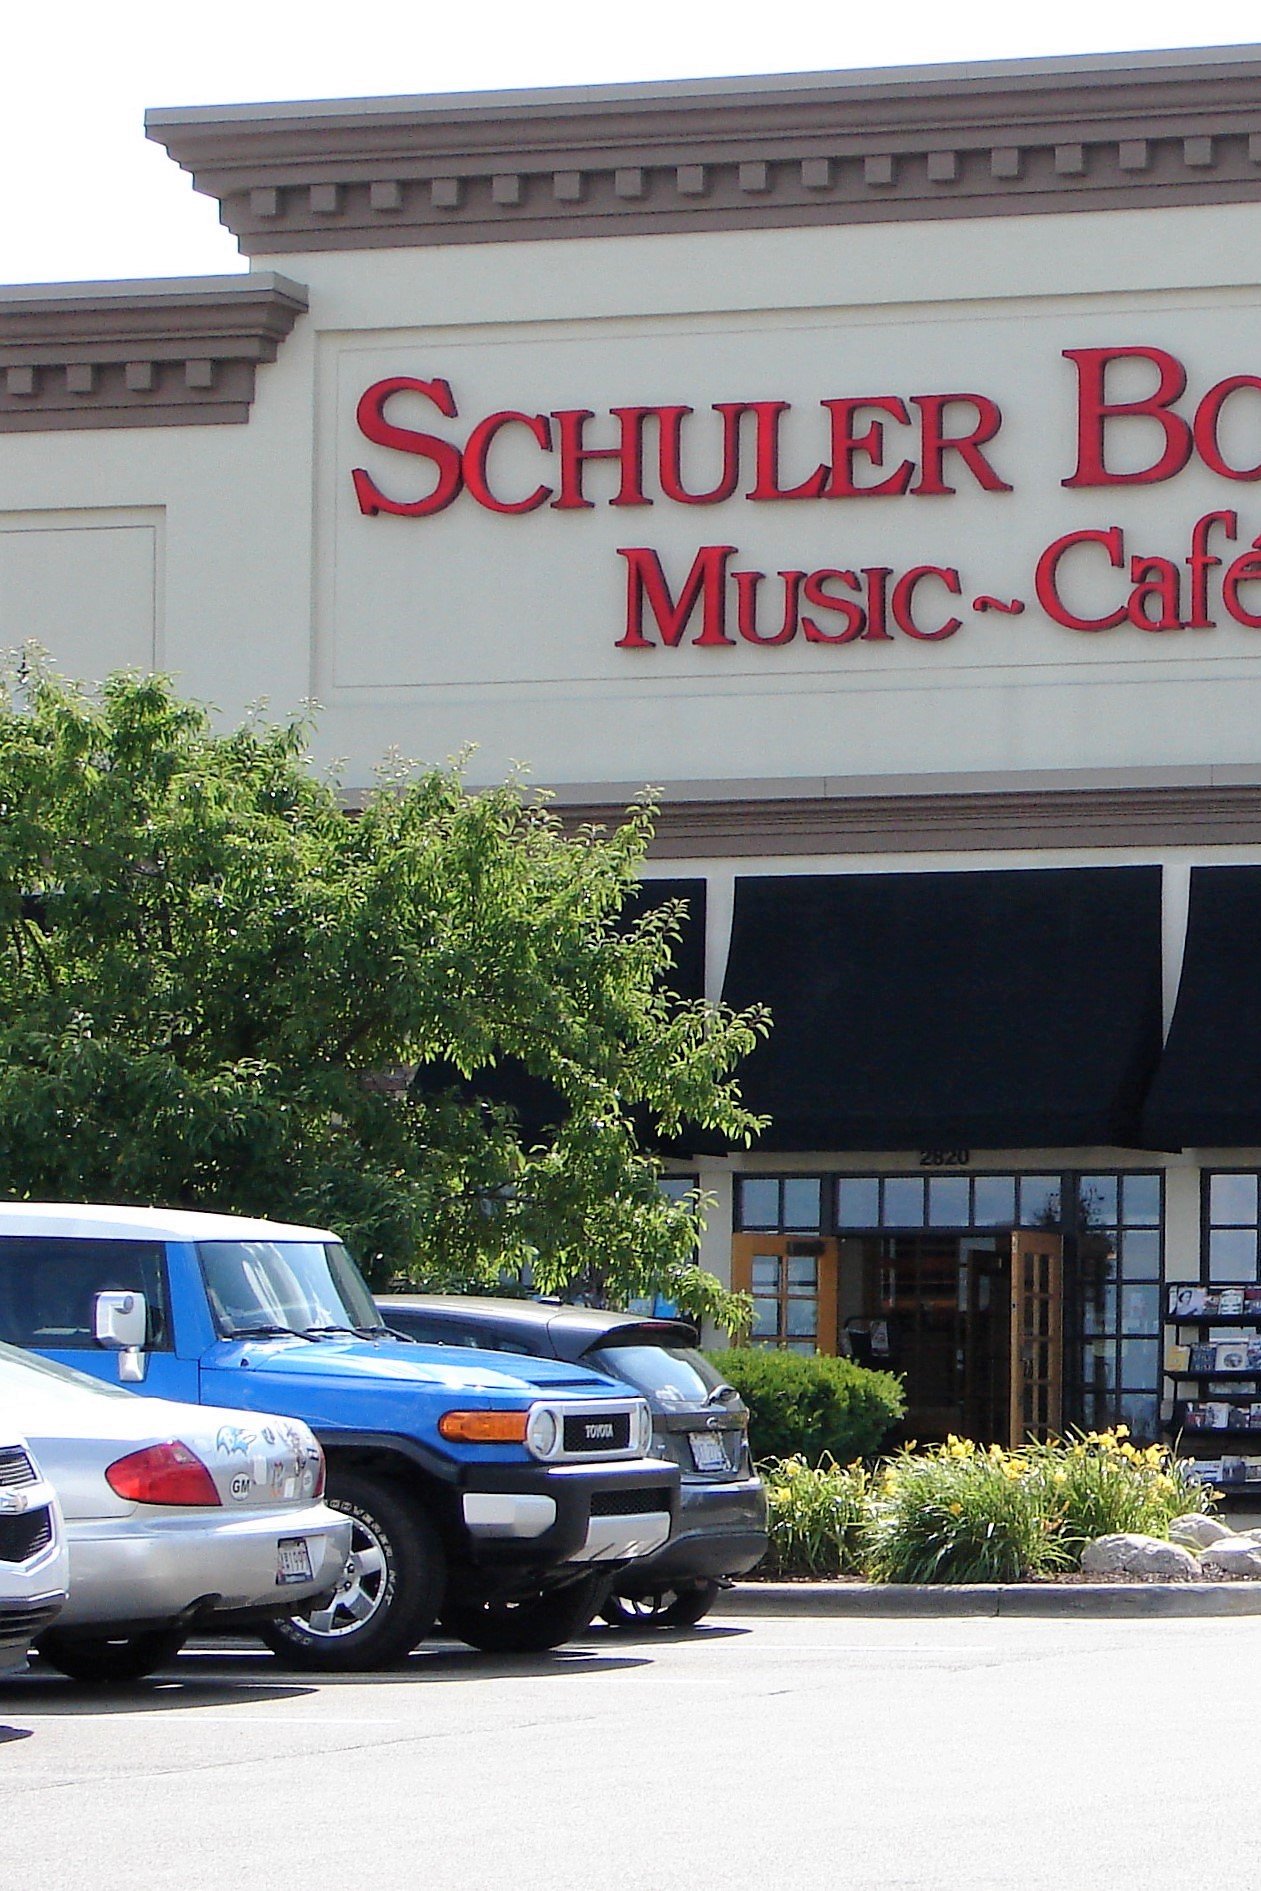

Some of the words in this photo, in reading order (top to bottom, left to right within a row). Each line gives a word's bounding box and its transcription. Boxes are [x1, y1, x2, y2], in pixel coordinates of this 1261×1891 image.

[351, 374, 1014, 517] SCHULER
[919, 1150, 970, 1166] 2820
[585, 1423, 614, 1439] TOYOTA
